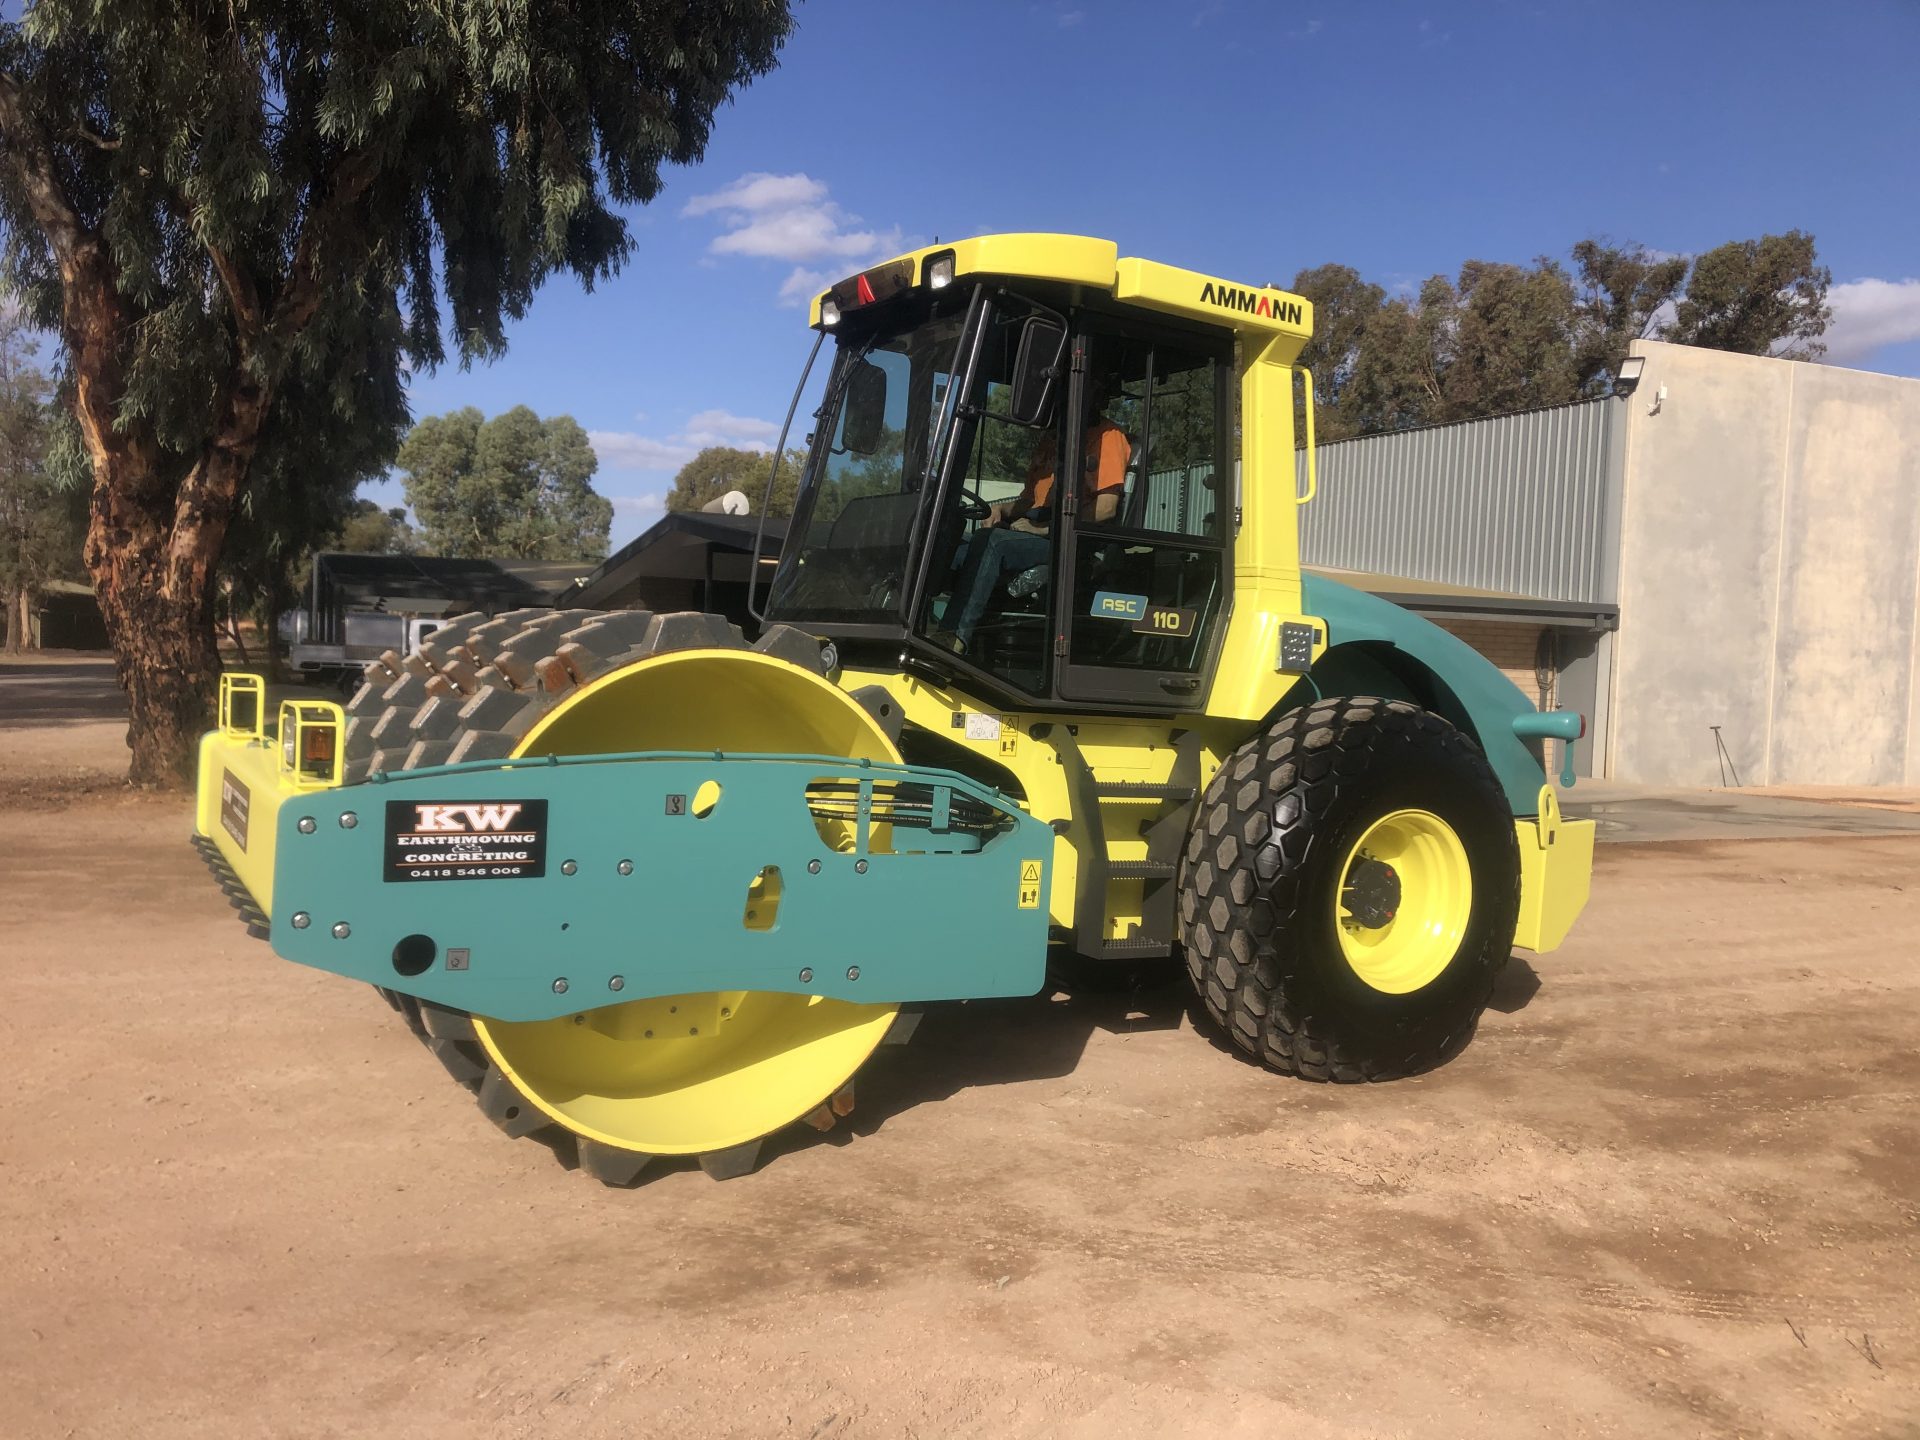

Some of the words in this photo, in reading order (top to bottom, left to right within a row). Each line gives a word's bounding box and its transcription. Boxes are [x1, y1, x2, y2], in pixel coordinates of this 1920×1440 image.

[1200, 282, 1302, 325] AMMANN
[1102, 598, 1137, 613] ASC
[1153, 611, 1180, 630] 110
[415, 803, 522, 832] KW
[397, 835, 536, 845] EARTHMOVING
[404, 851, 528, 863] CONCRETING
[410, 869, 452, 878] 0418
[457, 868, 486, 876] 546
[491, 867, 521, 875] 006
